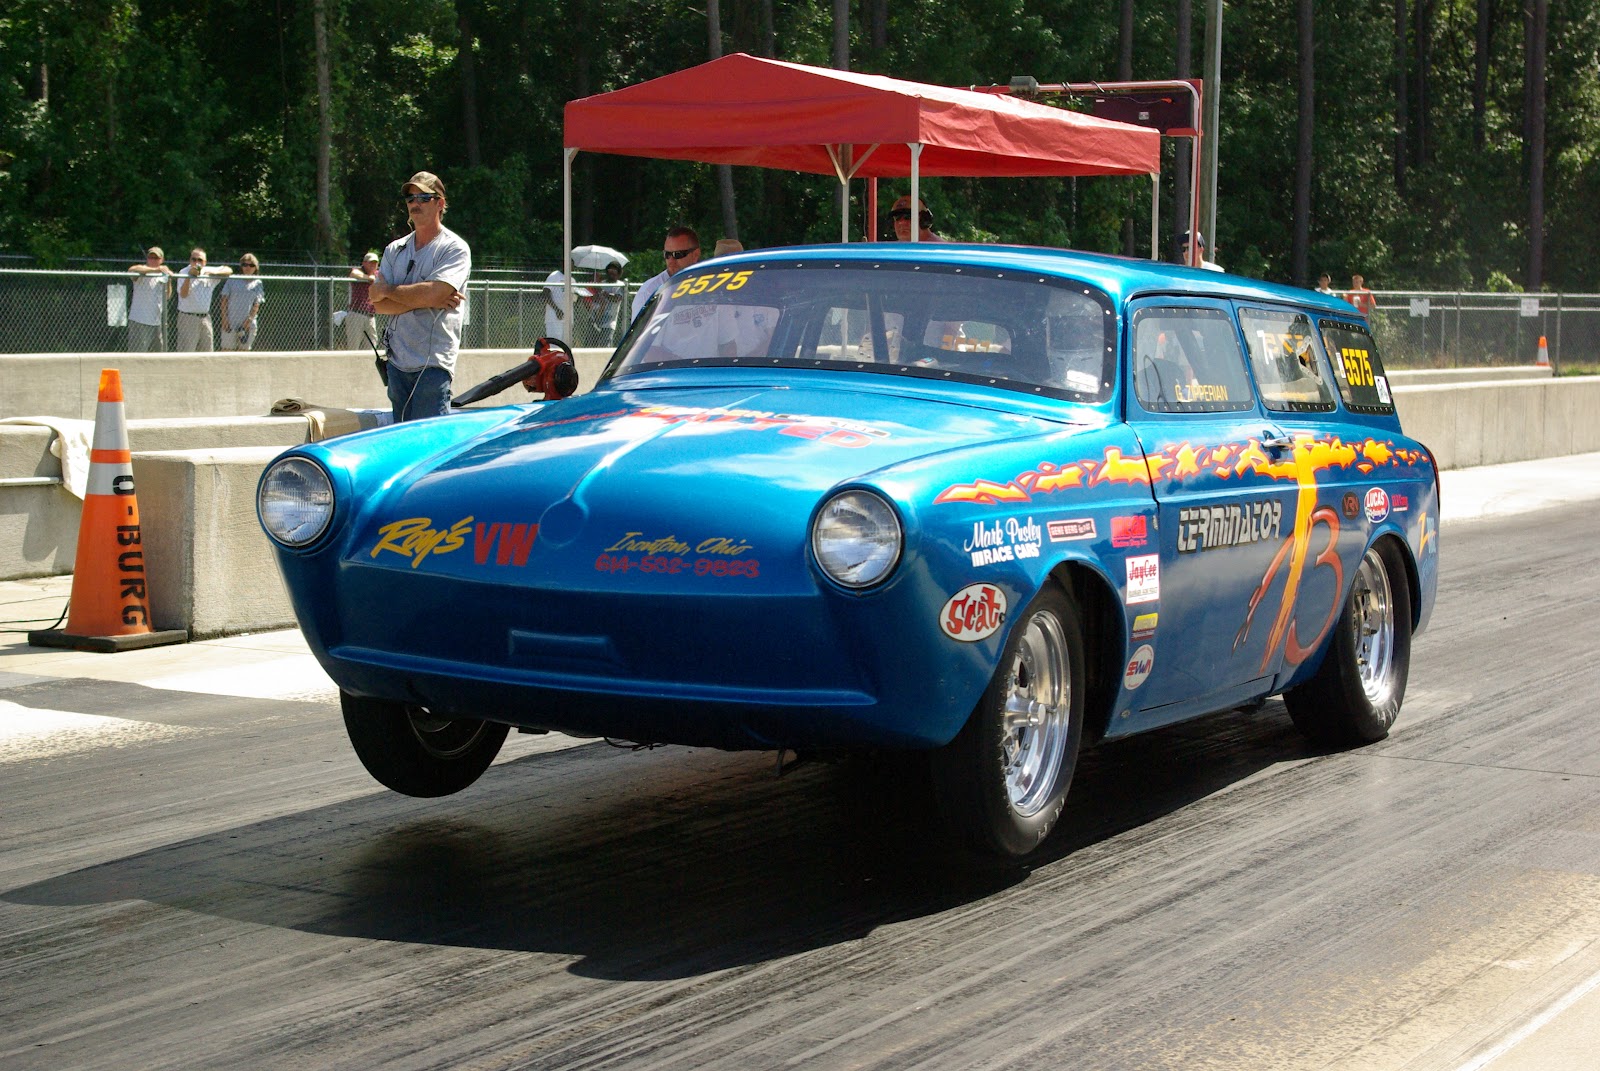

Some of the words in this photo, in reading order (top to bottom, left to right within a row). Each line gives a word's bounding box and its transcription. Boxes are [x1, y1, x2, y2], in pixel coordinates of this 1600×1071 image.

[671, 271, 755, 299] 5575
[1341, 347, 1375, 387] 5575
[1366, 491, 1385, 508] LUCAS
[370, 516, 473, 568] Ray's
[474, 522, 539, 567] VW
[963, 519, 1004, 552] Mark
[1177, 499, 1282, 553] TERMINATOR
[695, 537, 753, 556] Ohio
[983, 545, 1015, 565] RACE
[1014, 542, 1040, 559] CARS
[946, 586, 1001, 635] Scat
